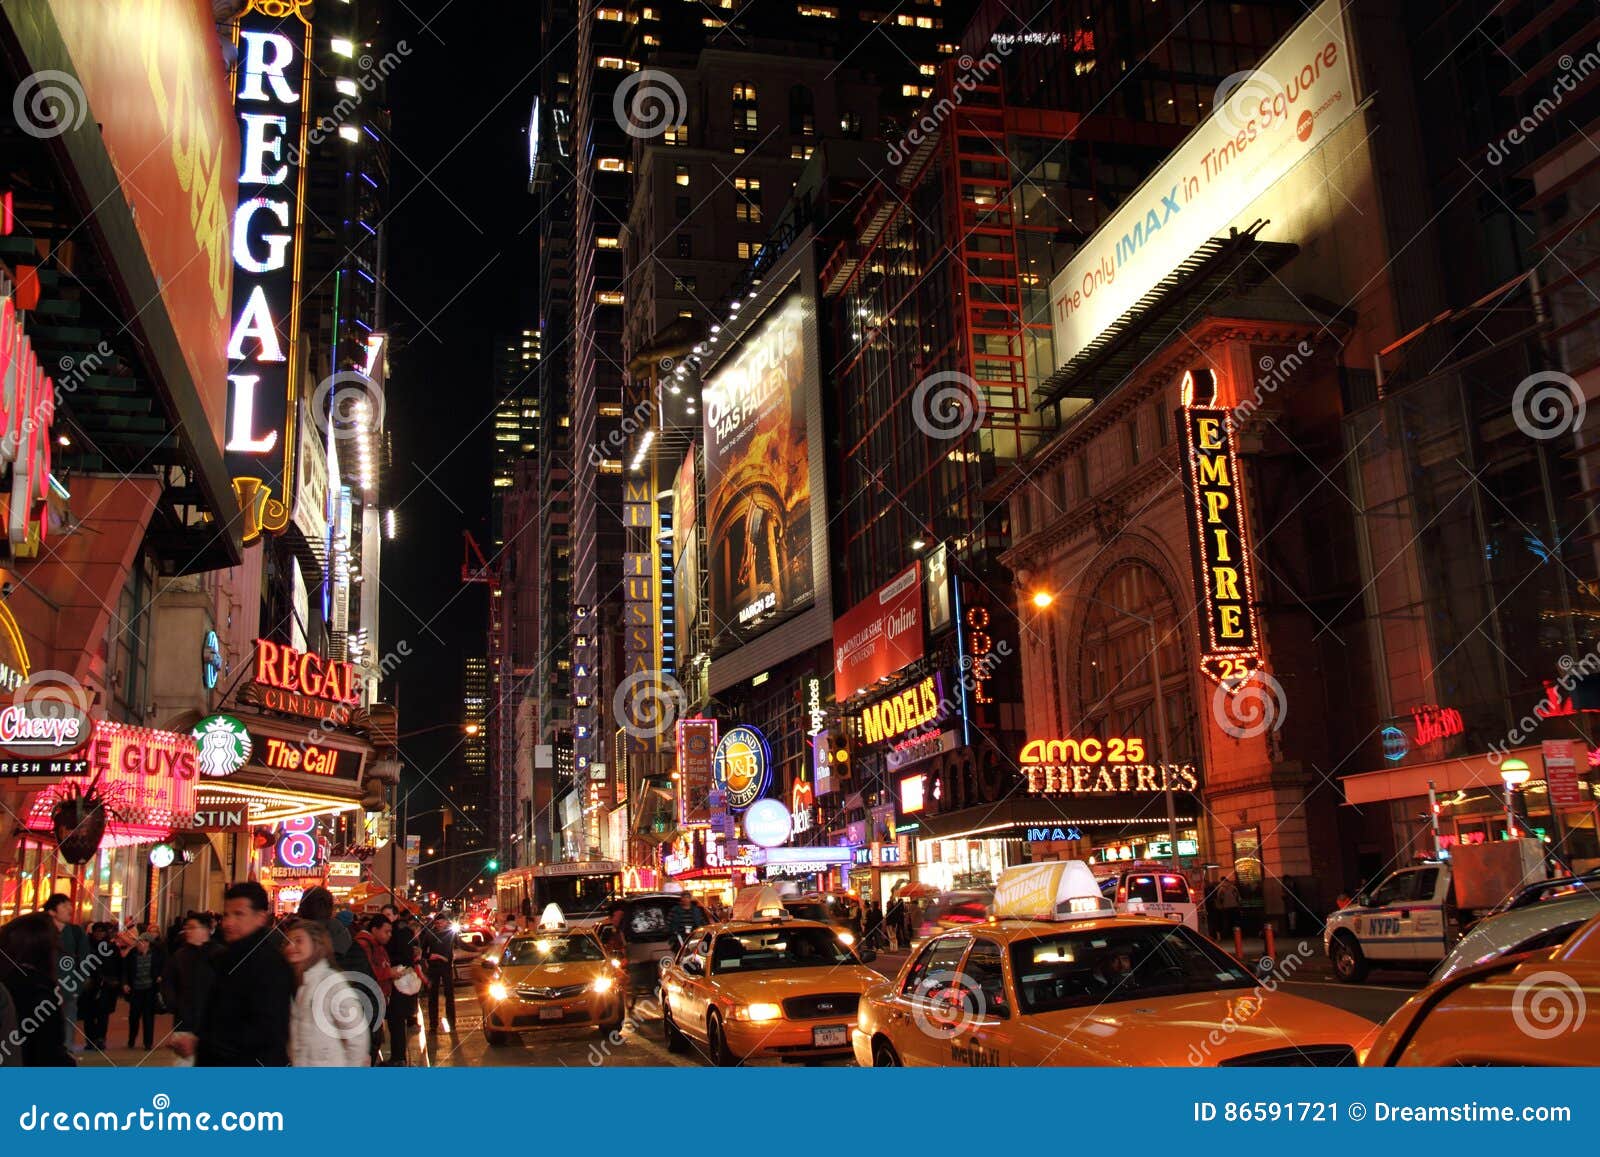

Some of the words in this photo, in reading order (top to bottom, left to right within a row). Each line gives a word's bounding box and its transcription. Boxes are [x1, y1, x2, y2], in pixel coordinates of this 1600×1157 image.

[1056, 289, 1080, 323] The
[1082, 256, 1115, 298] Only
[1117, 186, 1181, 268] IMAX
[1183, 176, 1199, 203] in
[1200, 119, 1257, 184] Times
[1259, 42, 1338, 128] Square
[225, 31, 299, 453] REGAL
[716, 406, 741, 445] HAS
[742, 360, 788, 421] FALLEN
[1197, 417, 1244, 639] EMPIRE
[739, 598, 764, 624] MARCH
[888, 607, 916, 640] Online
[256, 638, 360, 705] REGAL
[577, 607, 588, 767] CHAMPS
[1217, 659, 1249, 680] 25
[265, 689, 351, 724] CINEMAS
[862, 676, 937, 745] MODELL'S
[0, 706, 80, 746] Chevys
[123, 744, 196, 780] GUYS
[267, 738, 300, 769] The
[303, 745, 338, 775] Call
[718, 754, 758, 782] D&B
[1107, 738, 1145, 763] 25
[1020, 763, 1198, 793] THEATRES
[1027, 828, 1081, 841] IMAX
[272, 867, 323, 878] RESTAURANT
[1369, 917, 1400, 936] NYPD
